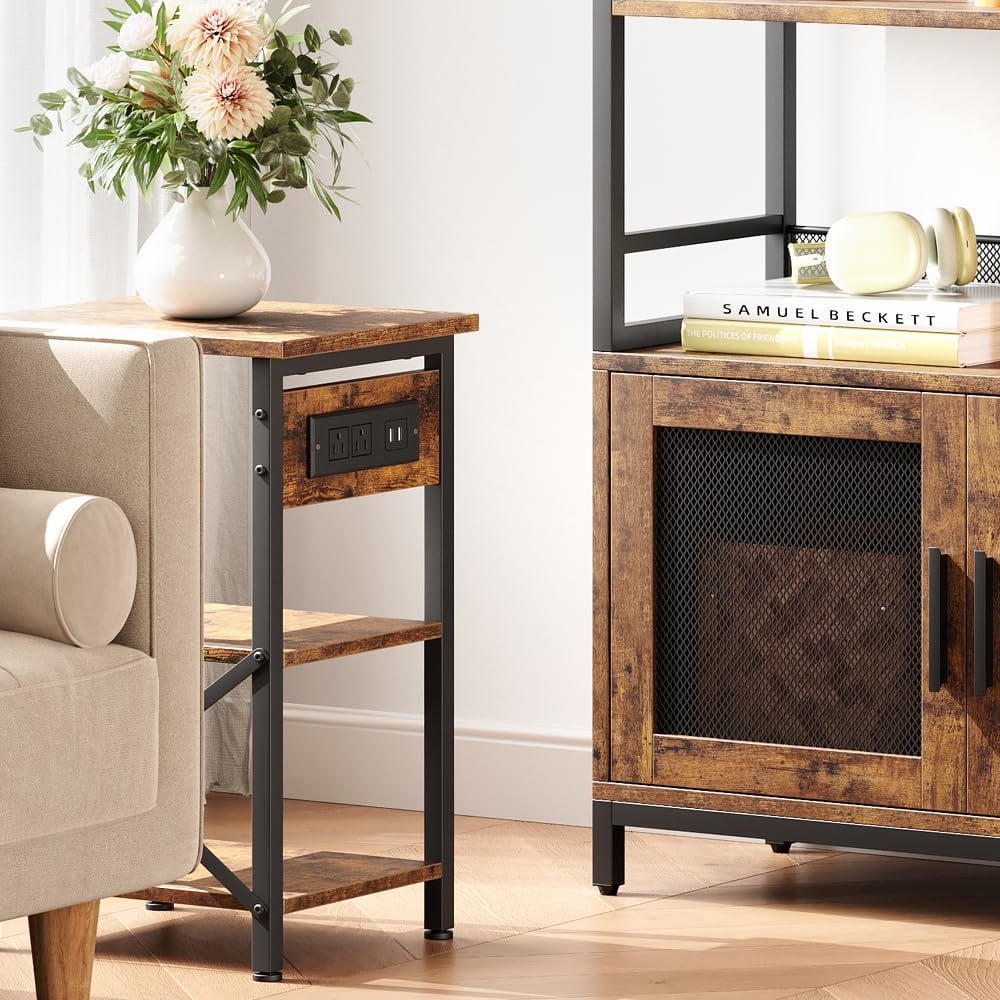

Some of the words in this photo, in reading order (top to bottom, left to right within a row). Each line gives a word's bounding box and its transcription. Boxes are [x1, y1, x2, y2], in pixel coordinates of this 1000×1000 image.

[722, 303, 820, 320] SAMUEL
[829, 309, 936, 327] BECKETT
[687, 329, 702, 338] THE
